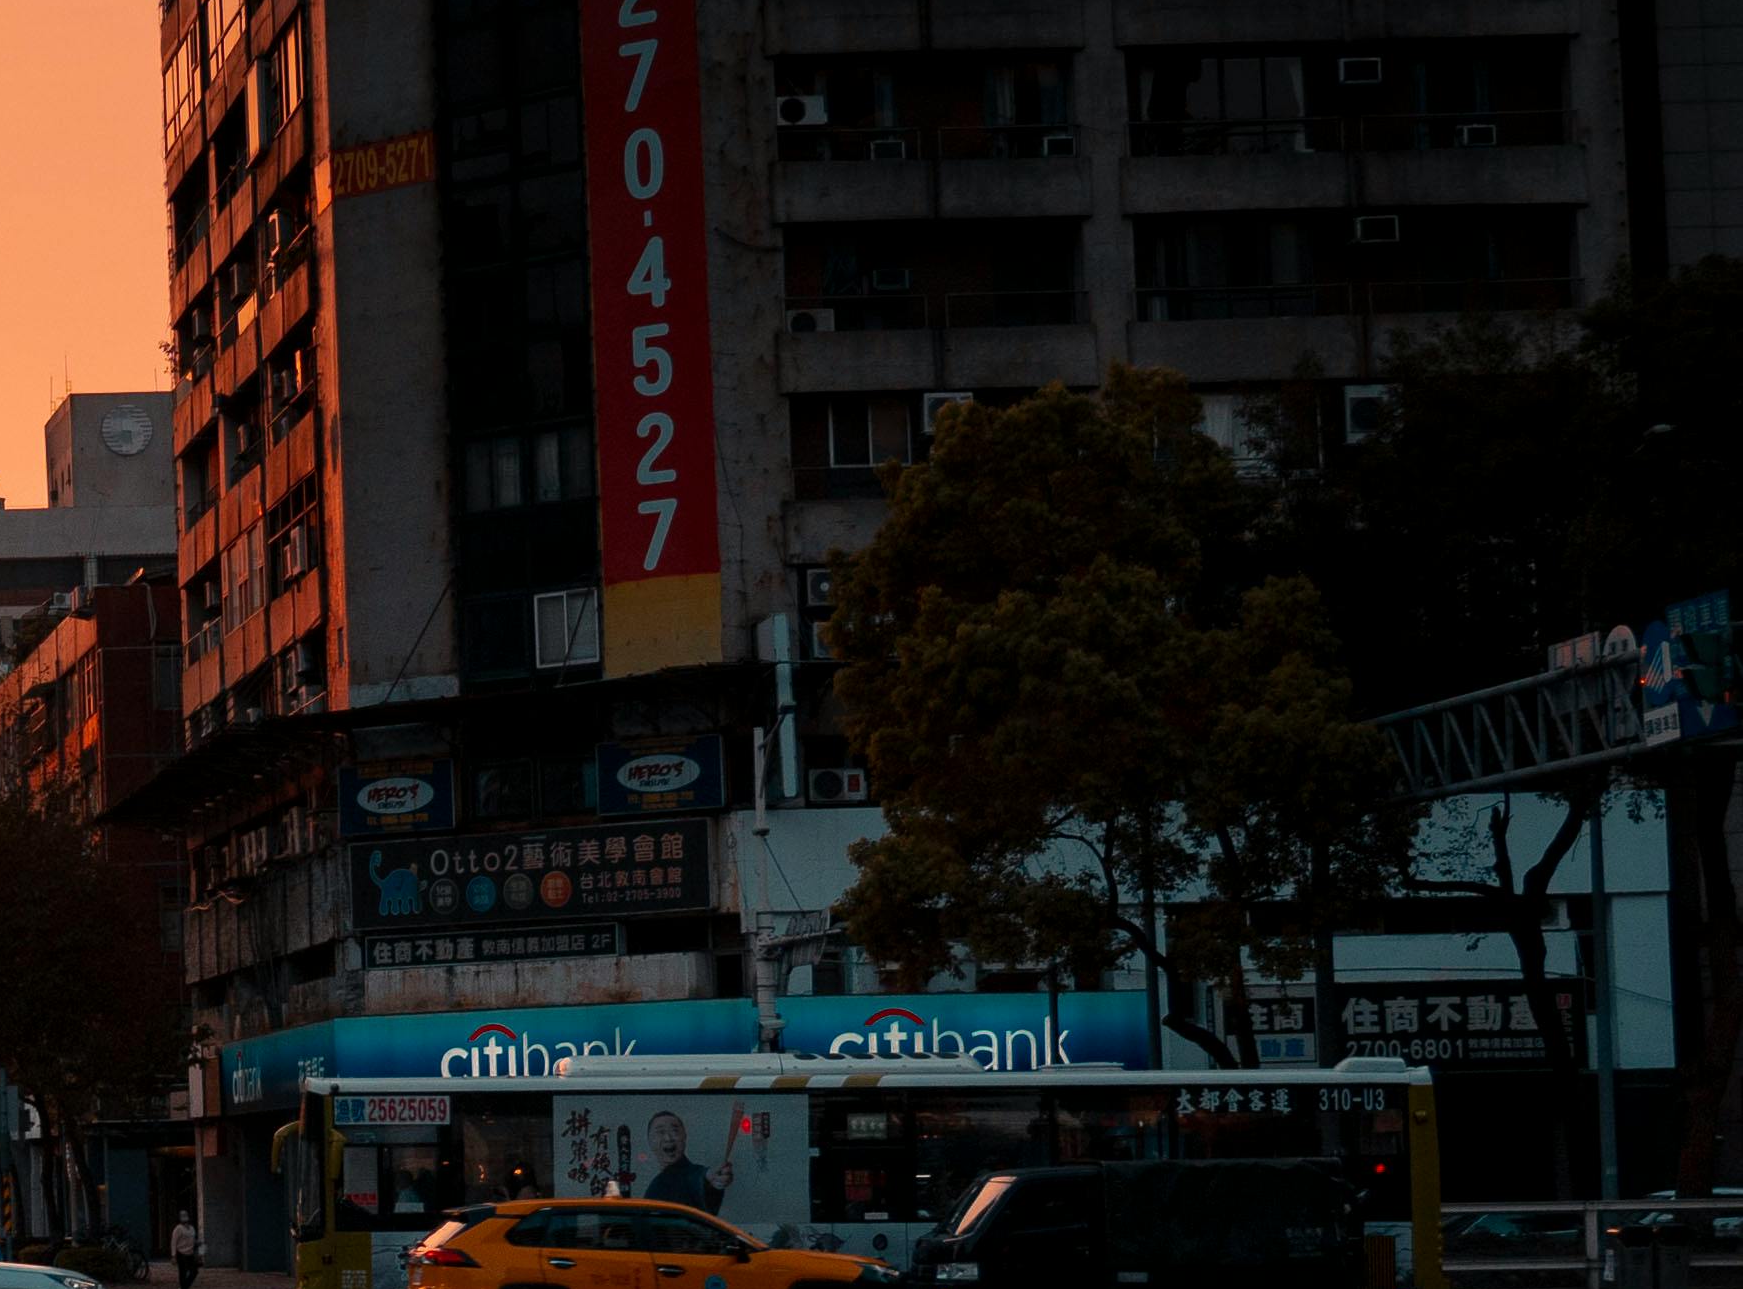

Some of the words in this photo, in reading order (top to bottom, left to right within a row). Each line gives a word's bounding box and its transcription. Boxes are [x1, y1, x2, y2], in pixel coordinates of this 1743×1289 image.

[333, 136, 430, 195] 2709-5271
[429, 832, 685, 876] Otto2藝術美學會館
[579, 866, 683, 890] 台北敦南會館
[373, 936, 474, 966] 住商不動產
[591, 933, 611, 950] 2F
[1342, 995, 1541, 1036] 住商不動產
[1345, 1039, 1465, 1061] 2700-6801
[368, 1098, 448, 1123] 25625059
[1175, 1086, 1294, 1113] 大都會客運
[1318, 1088, 1386, 1112] 310-U3
